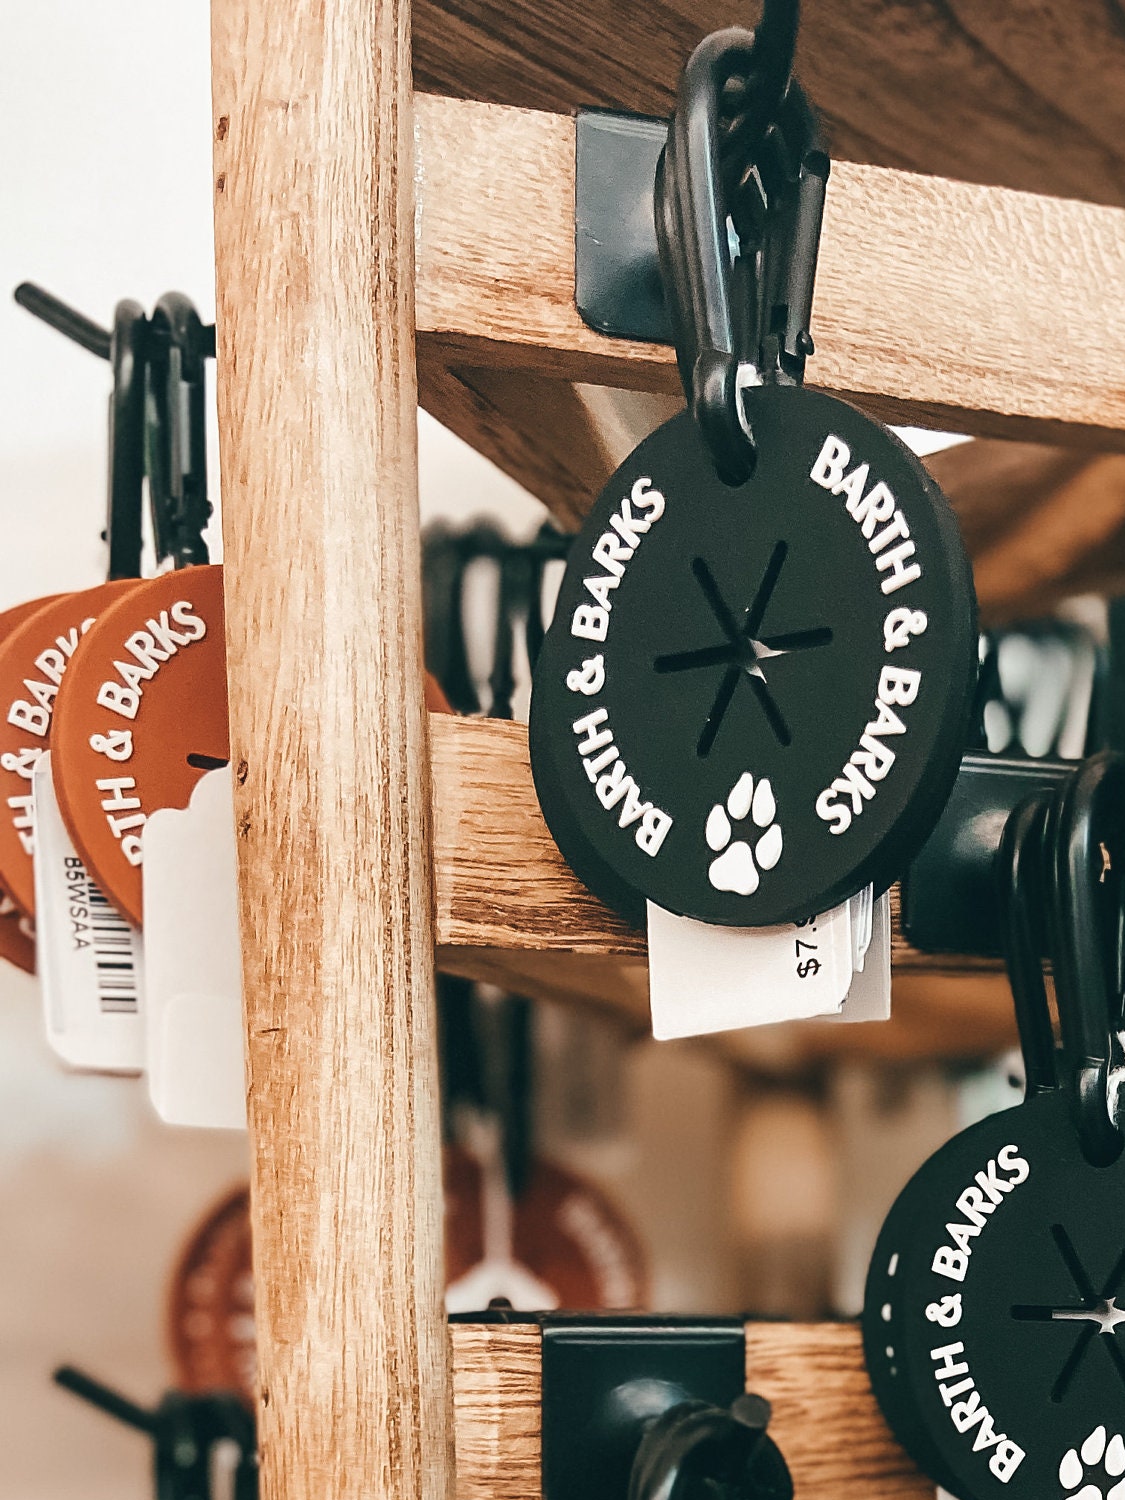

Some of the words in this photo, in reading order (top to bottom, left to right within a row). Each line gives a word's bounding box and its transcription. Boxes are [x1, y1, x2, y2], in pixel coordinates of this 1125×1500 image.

[571, 478, 665, 641] BARKS
[810, 435, 921, 594] BARTH
[97, 600, 207, 720] BARKS
[567, 655, 605, 695] &
[884, 607, 927, 652] &
[89, 730, 134, 761] &
[573, 707, 673, 857] BARTH
[816, 665, 921, 834] BARKS
[932, 1145, 1029, 1281] BARKS
[926, 1293, 962, 1327] &
[931, 1342, 1025, 1483] BARTH
